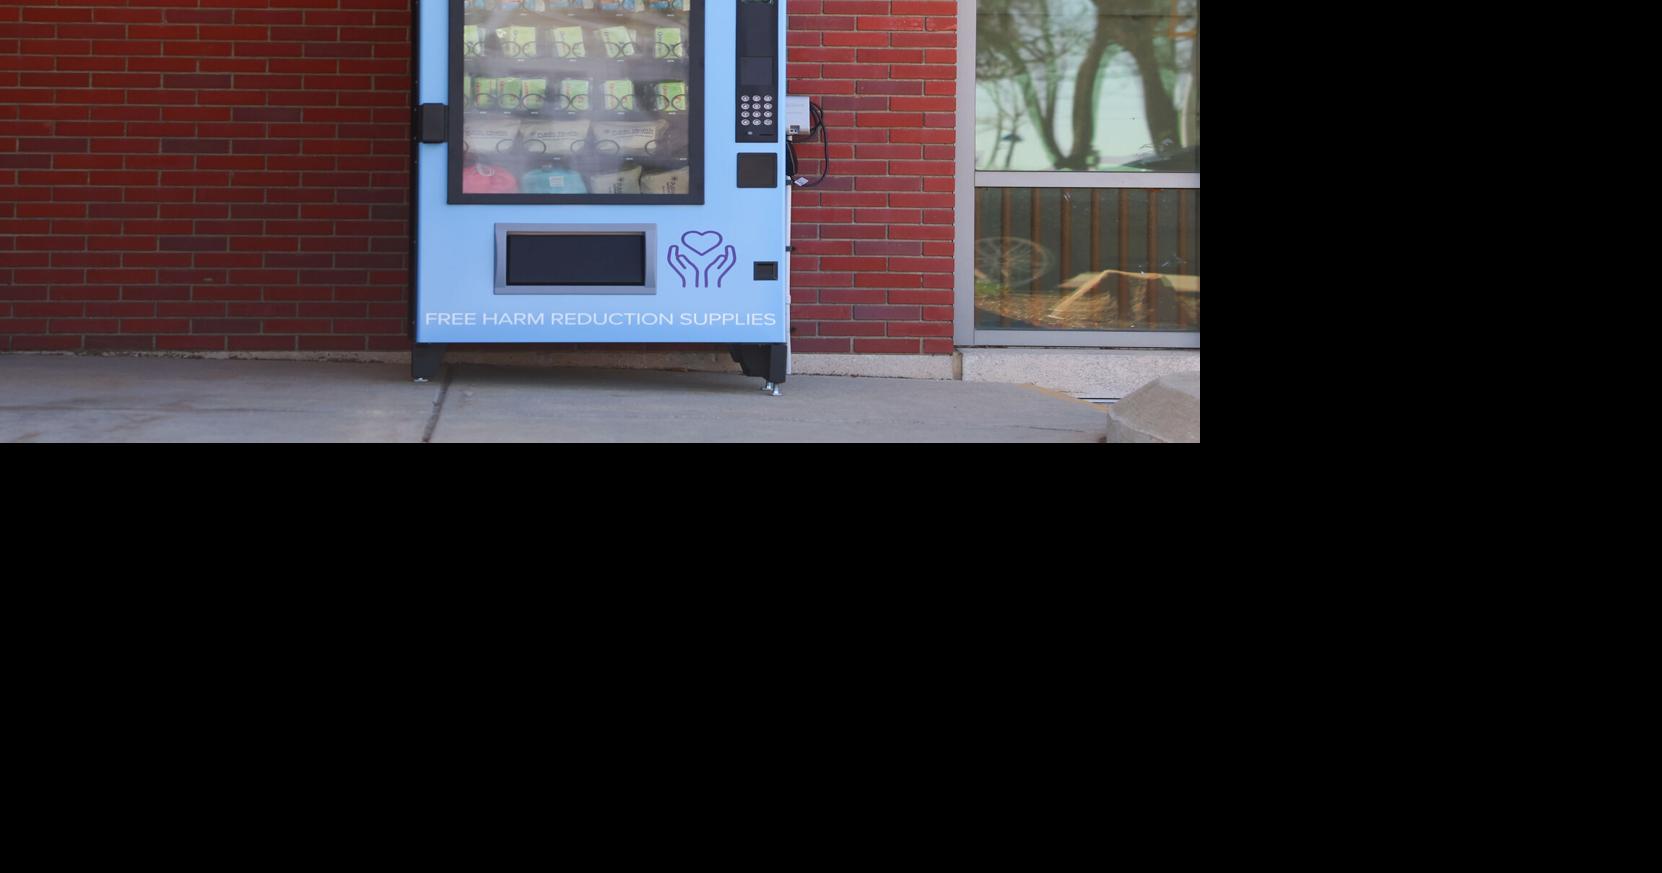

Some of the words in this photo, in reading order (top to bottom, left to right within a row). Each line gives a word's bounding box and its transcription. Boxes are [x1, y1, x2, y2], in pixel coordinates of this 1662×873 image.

[425, 312, 476, 326] FREE
[482, 312, 545, 326] HARM
[551, 312, 674, 326] REDUCTION
[679, 312, 776, 326] SUPPLIES
